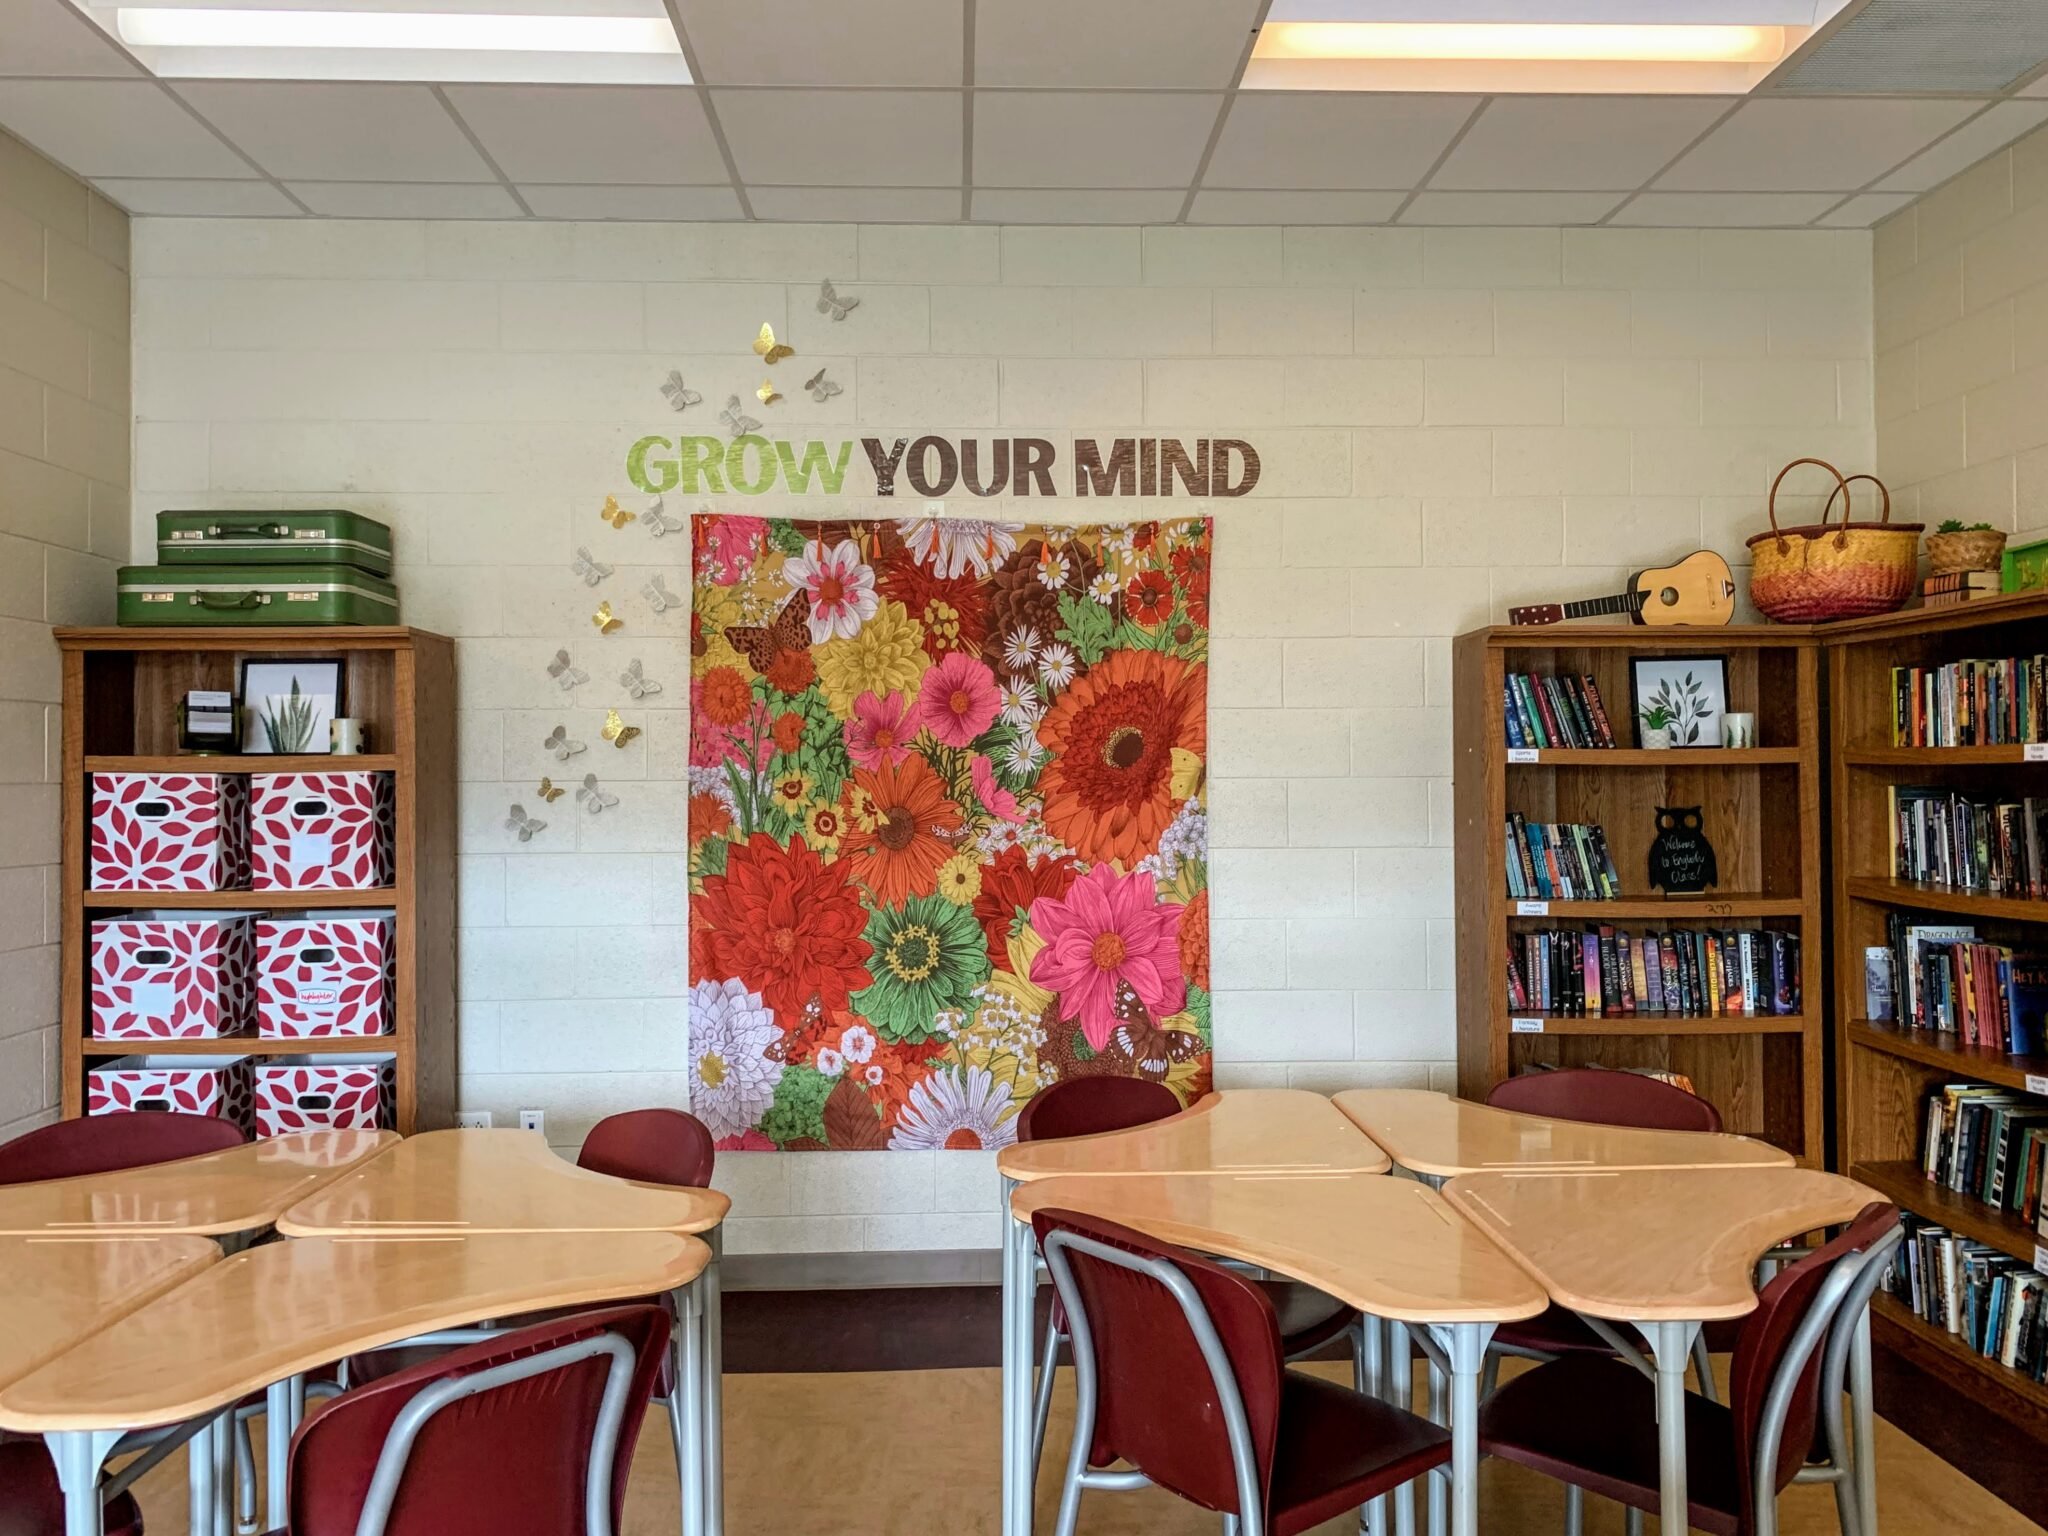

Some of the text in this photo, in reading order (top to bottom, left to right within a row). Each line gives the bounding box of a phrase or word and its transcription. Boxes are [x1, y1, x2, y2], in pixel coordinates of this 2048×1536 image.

[625, 435, 1262, 498] GROW YOUR MIND
[1918, 930, 1970, 940] DRAGON AGE
